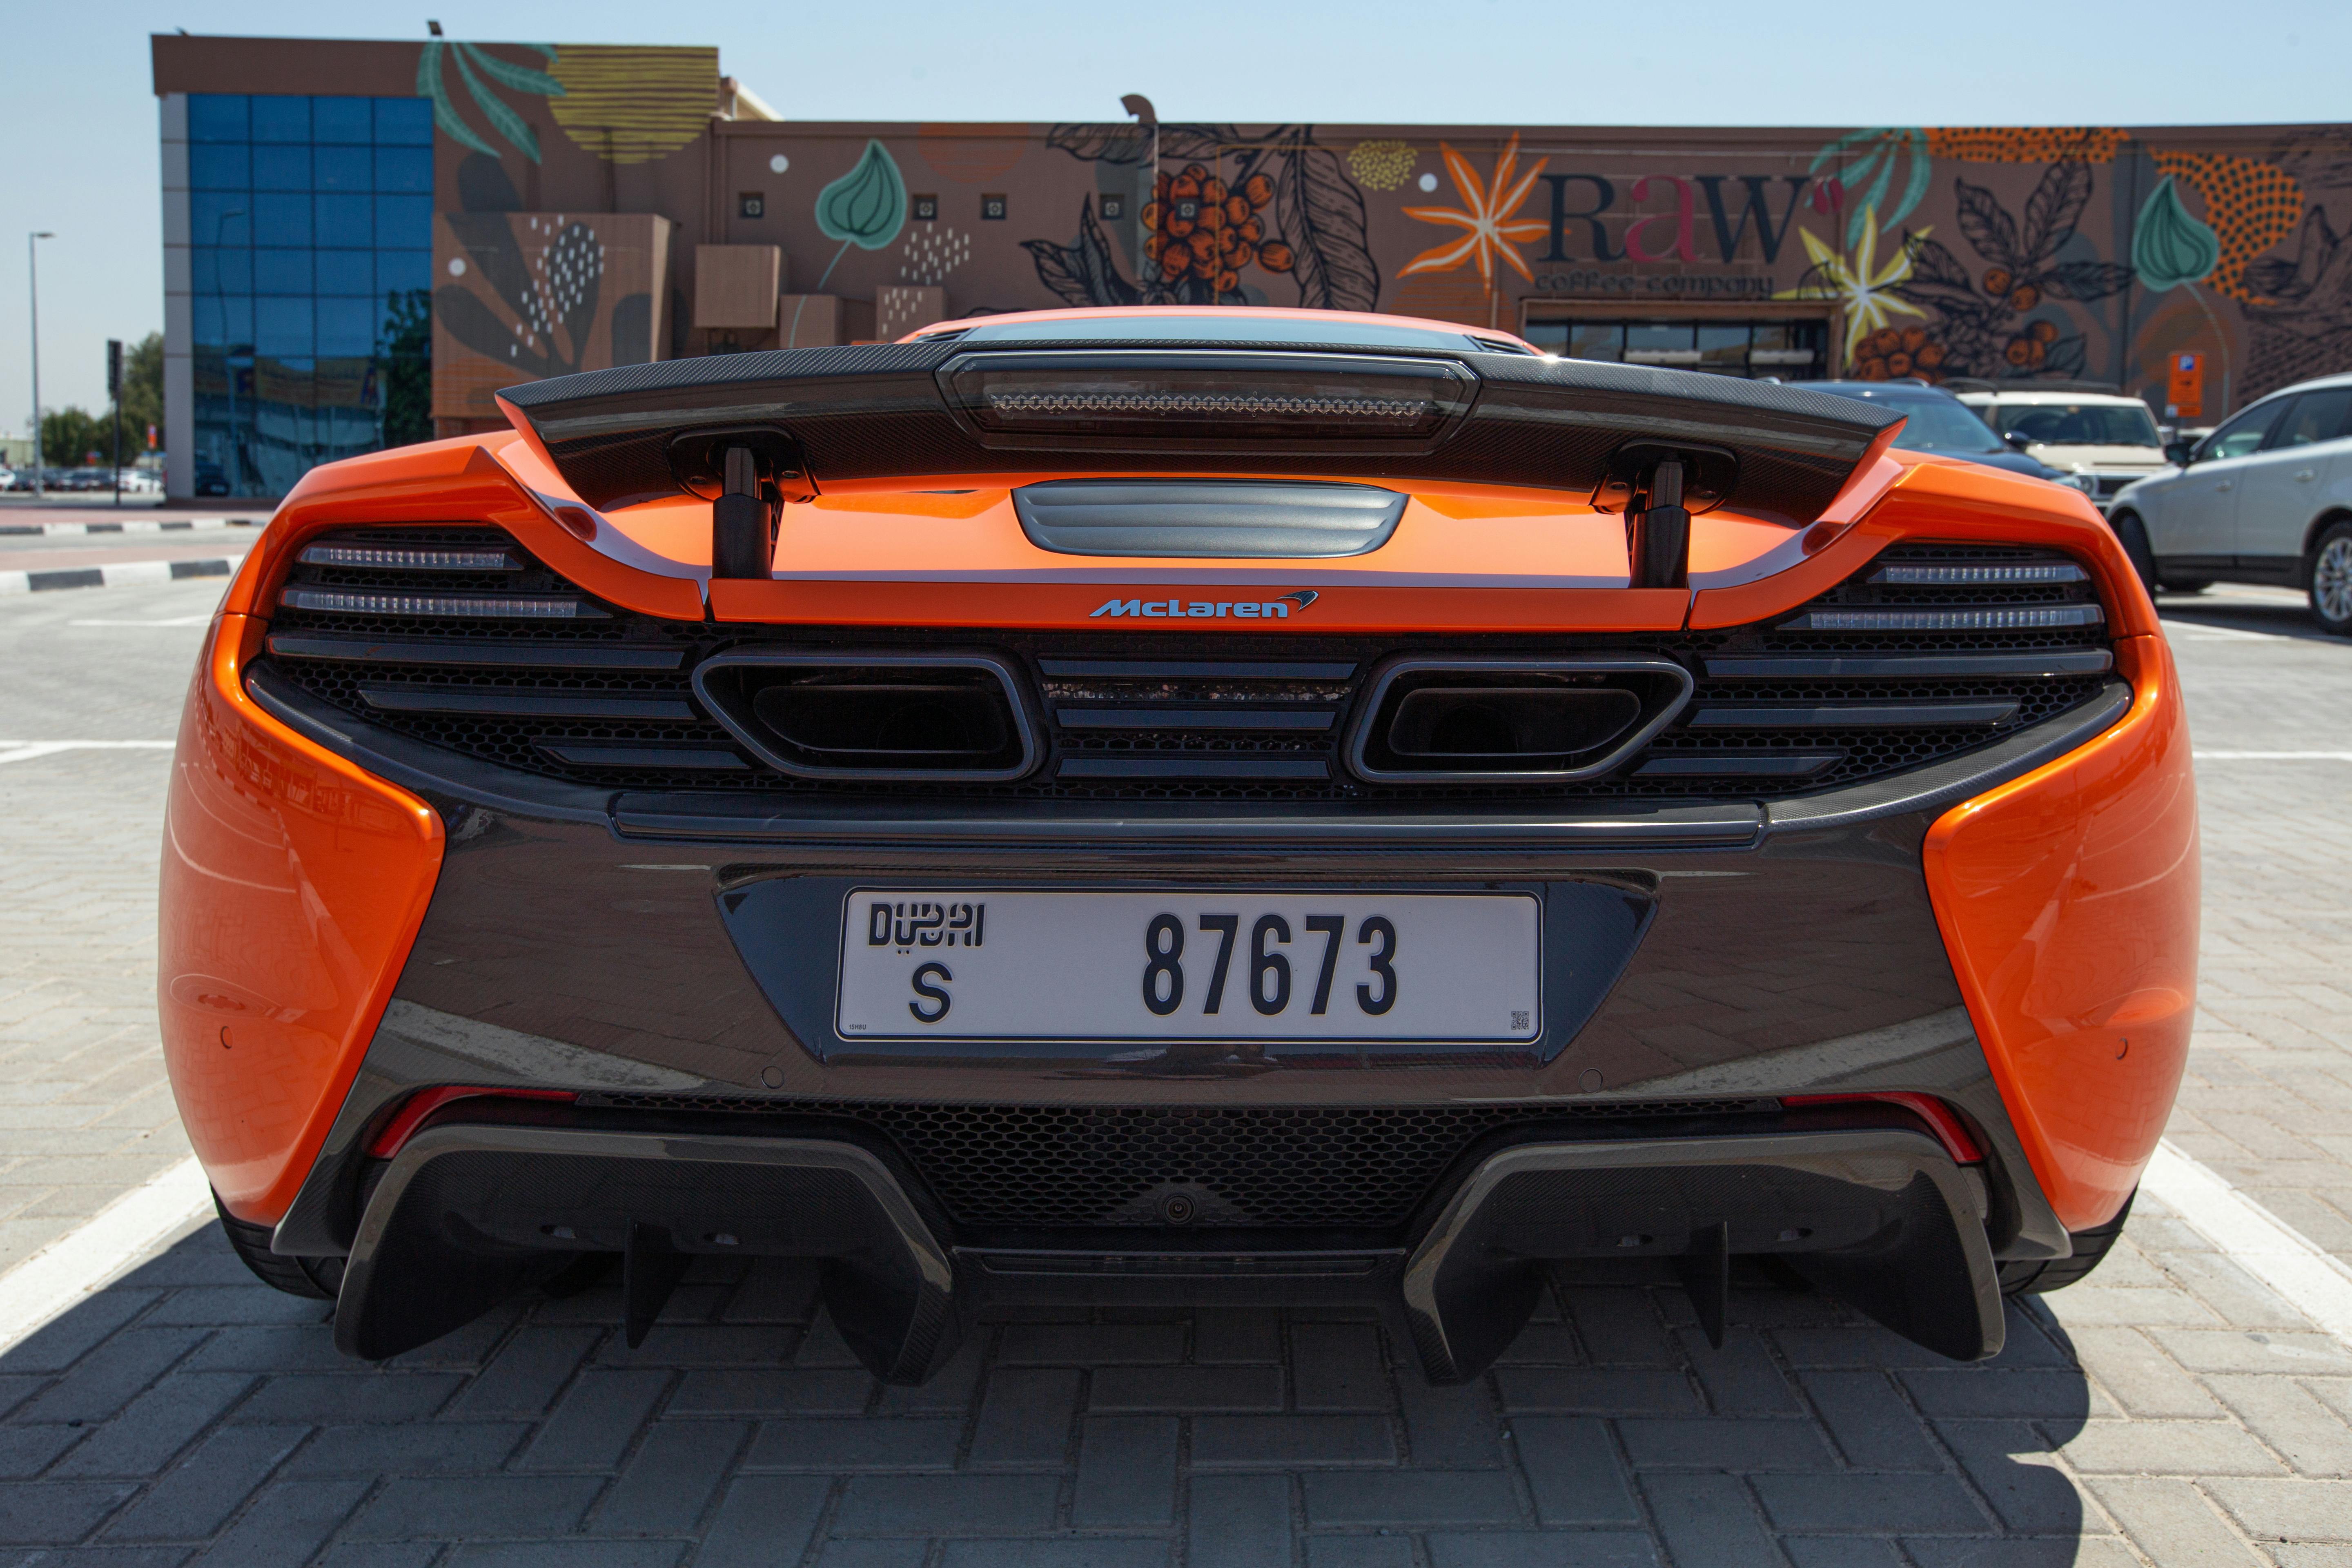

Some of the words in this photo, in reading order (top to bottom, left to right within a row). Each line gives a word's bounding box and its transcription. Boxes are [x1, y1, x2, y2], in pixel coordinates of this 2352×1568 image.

[1535, 270, 1635, 293] coffee
[1646, 274, 1774, 298] company
[1089, 599, 1288, 618] McLaren
[869, 903, 985, 947] DUBAI
[1143, 913, 1398, 1016] 87673
[909, 961, 953, 1024] S
